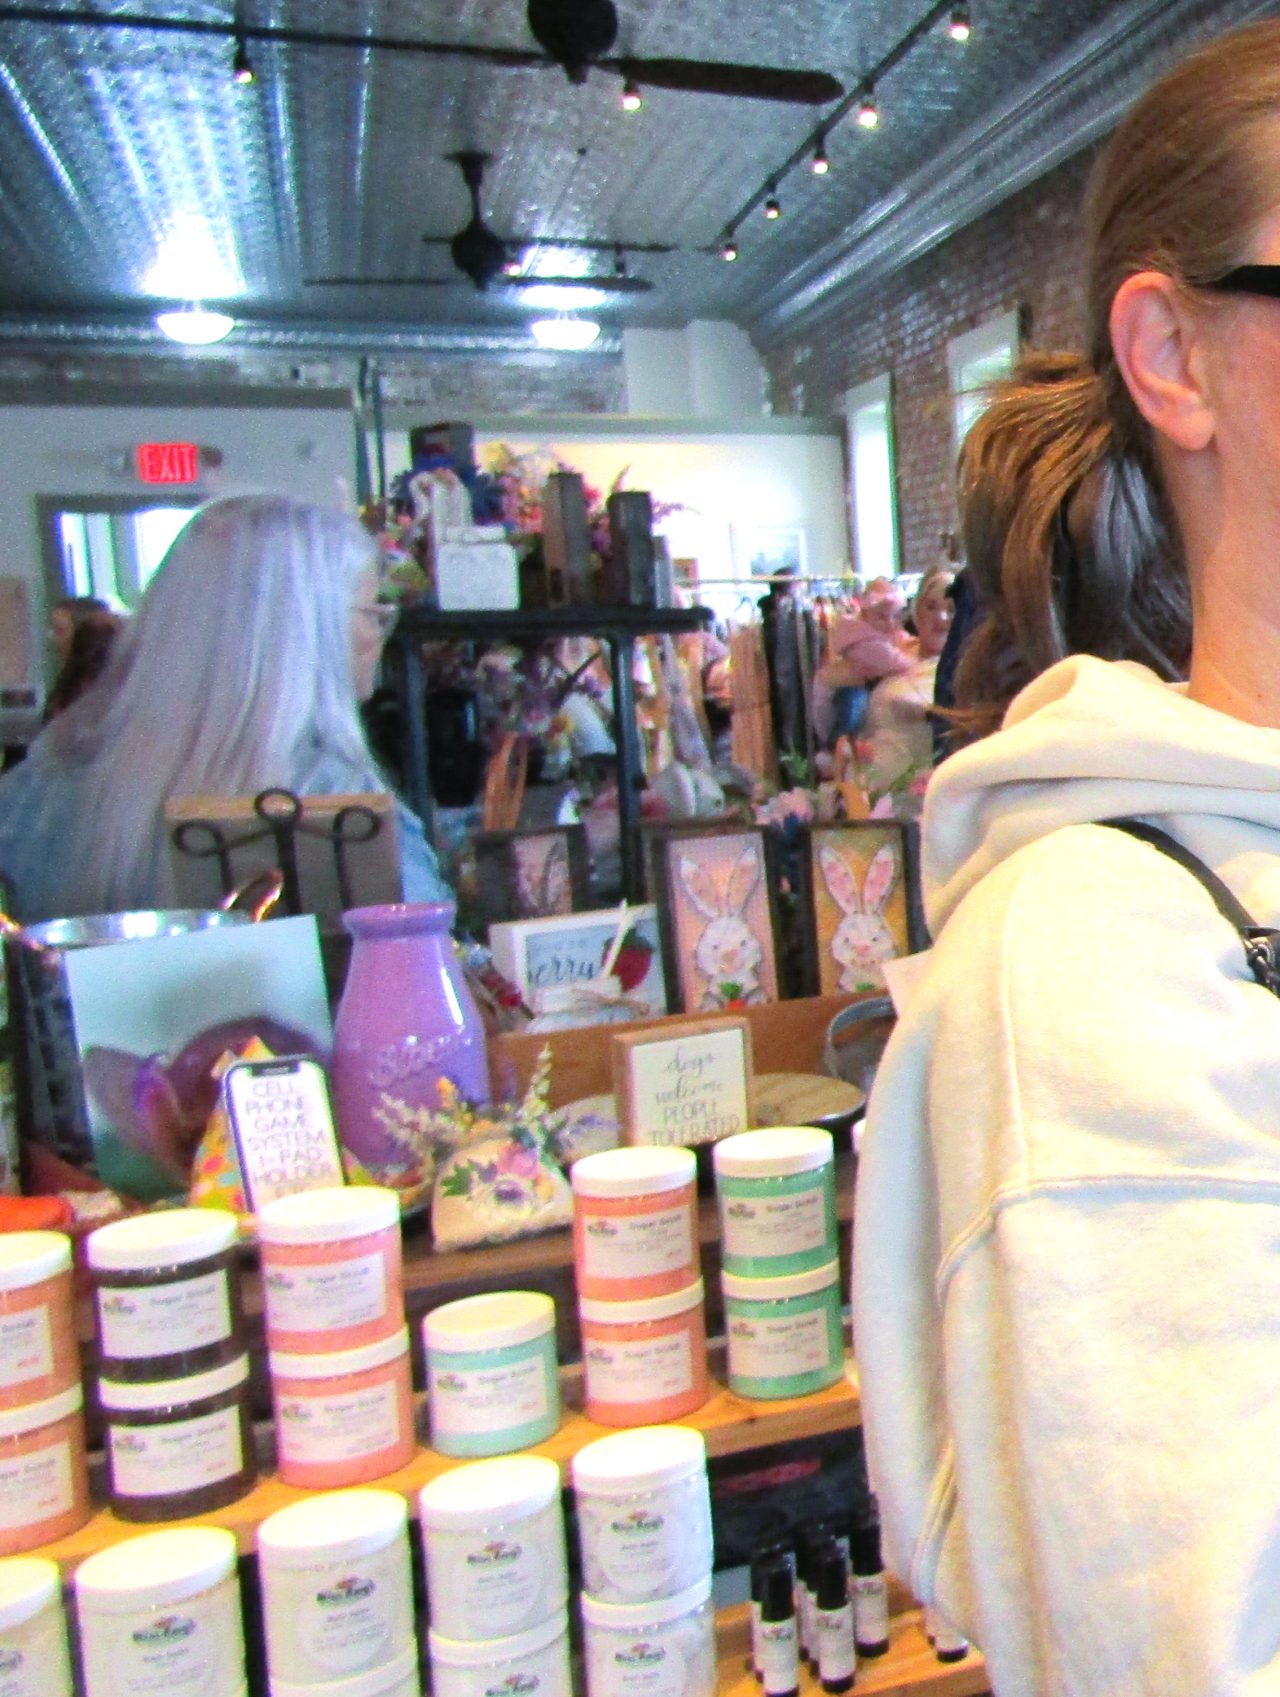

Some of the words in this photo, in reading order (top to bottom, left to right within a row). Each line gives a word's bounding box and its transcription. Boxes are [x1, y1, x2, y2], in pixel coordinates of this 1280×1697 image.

[143, 446, 193, 480] EXIT
[252, 1079, 298, 1098] CELL
[245, 1095, 313, 1116] PHONE
[663, 1100, 718, 1125] PEOPLE
[254, 1112, 311, 1132] GAME
[247, 1128, 326, 1151] SYSTEM
[253, 1161, 333, 1186] HOLDER
